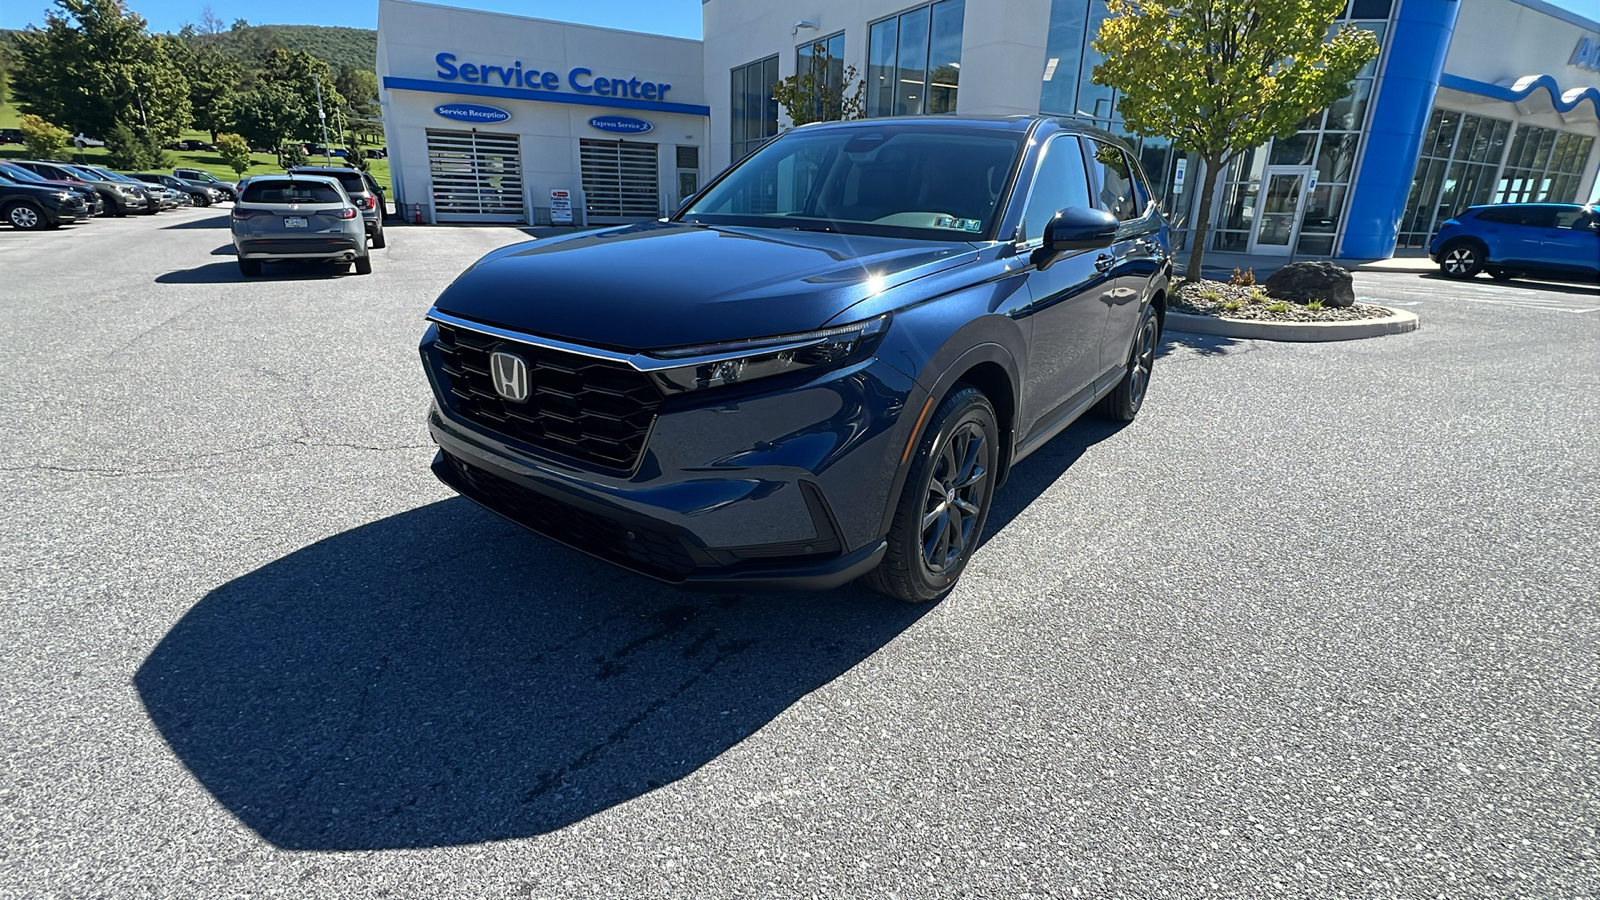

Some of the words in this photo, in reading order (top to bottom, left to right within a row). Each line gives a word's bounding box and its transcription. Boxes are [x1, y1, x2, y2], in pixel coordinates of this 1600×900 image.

[435, 52, 559, 90] Service
[568, 67, 671, 100] Center
[439, 107, 468, 116] Service
[469, 109, 506, 119] Reception
[592, 119, 617, 128] Express
[617, 121, 640, 129] Service
